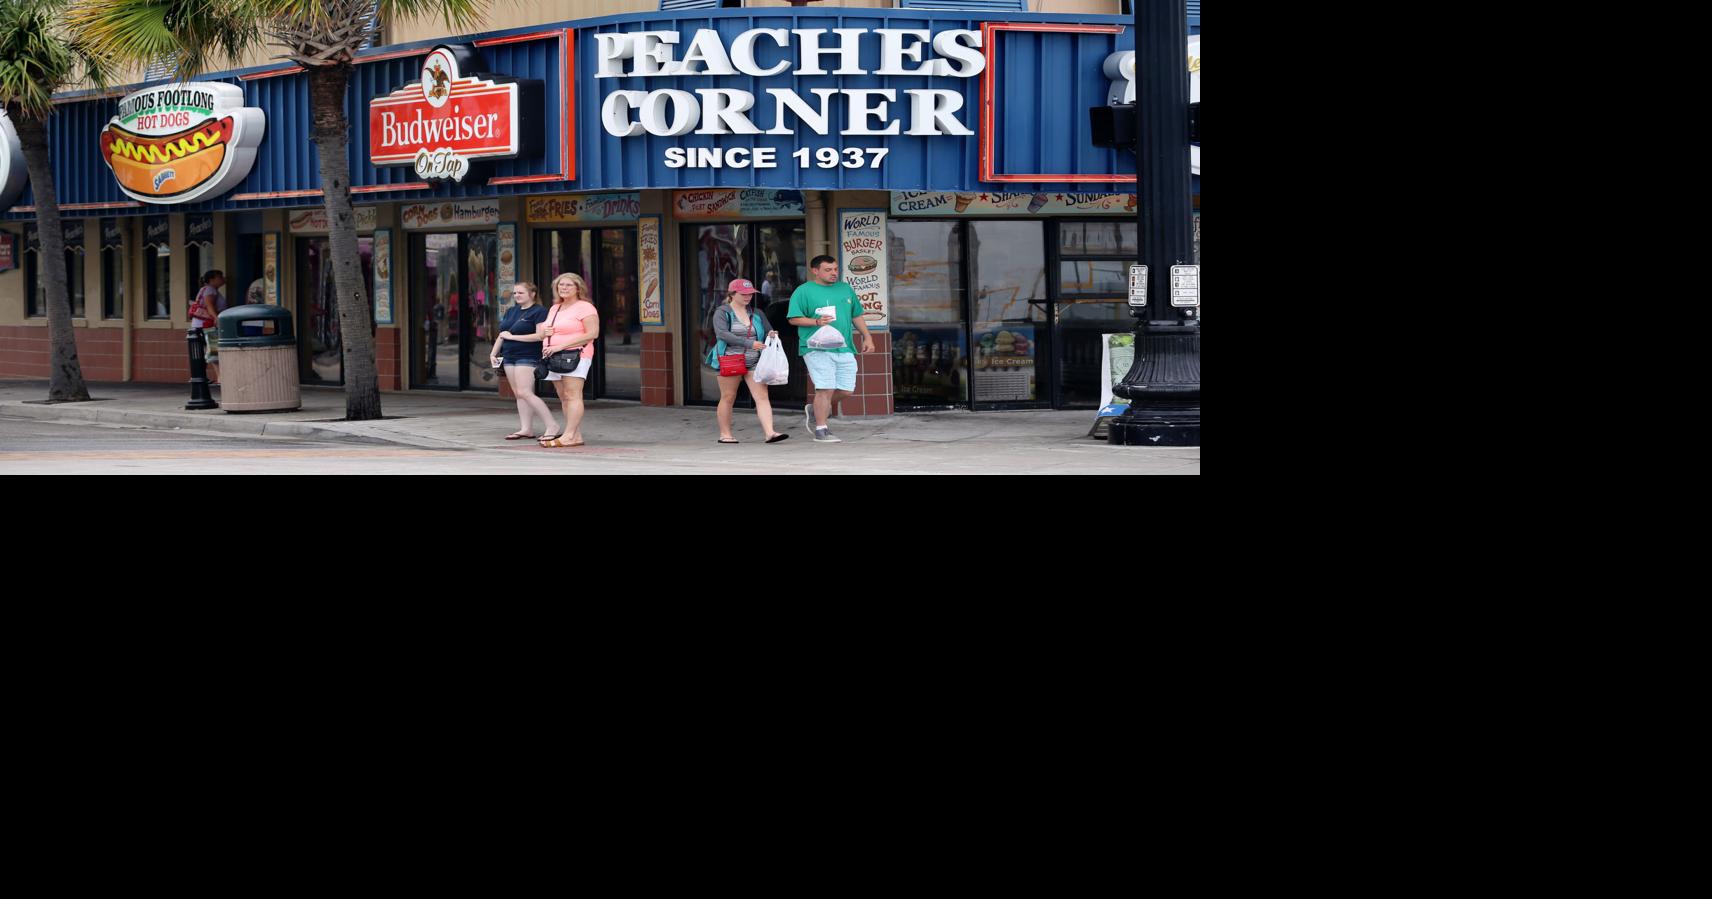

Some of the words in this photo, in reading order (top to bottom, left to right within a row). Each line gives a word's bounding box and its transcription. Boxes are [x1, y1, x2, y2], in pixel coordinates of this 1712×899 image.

[594, 27, 986, 78] PEACHES
[118, 92, 155, 120] FAMOUS
[157, 89, 214, 111] FOOTLONG
[601, 87, 975, 137] CORNER
[137, 115, 157, 130] HOT
[159, 111, 190, 128] DOGS
[381, 104, 498, 147] Budweiser
[415, 152, 434, 173] On
[434, 150, 463, 177] Tap
[664, 147, 778, 168] SINCE
[792, 147, 889, 169] 1937
[548, 198, 578, 219] FRIES
[898, 195, 948, 212] CREAM
[844, 215, 880, 230] WORLD
[846, 230, 881, 238] FAMOUS
[843, 238, 883, 252] BURGER
[846, 274, 879, 286] WORLD
[857, 292, 879, 302] OOT
[1006, 358, 1034, 366] Cream
